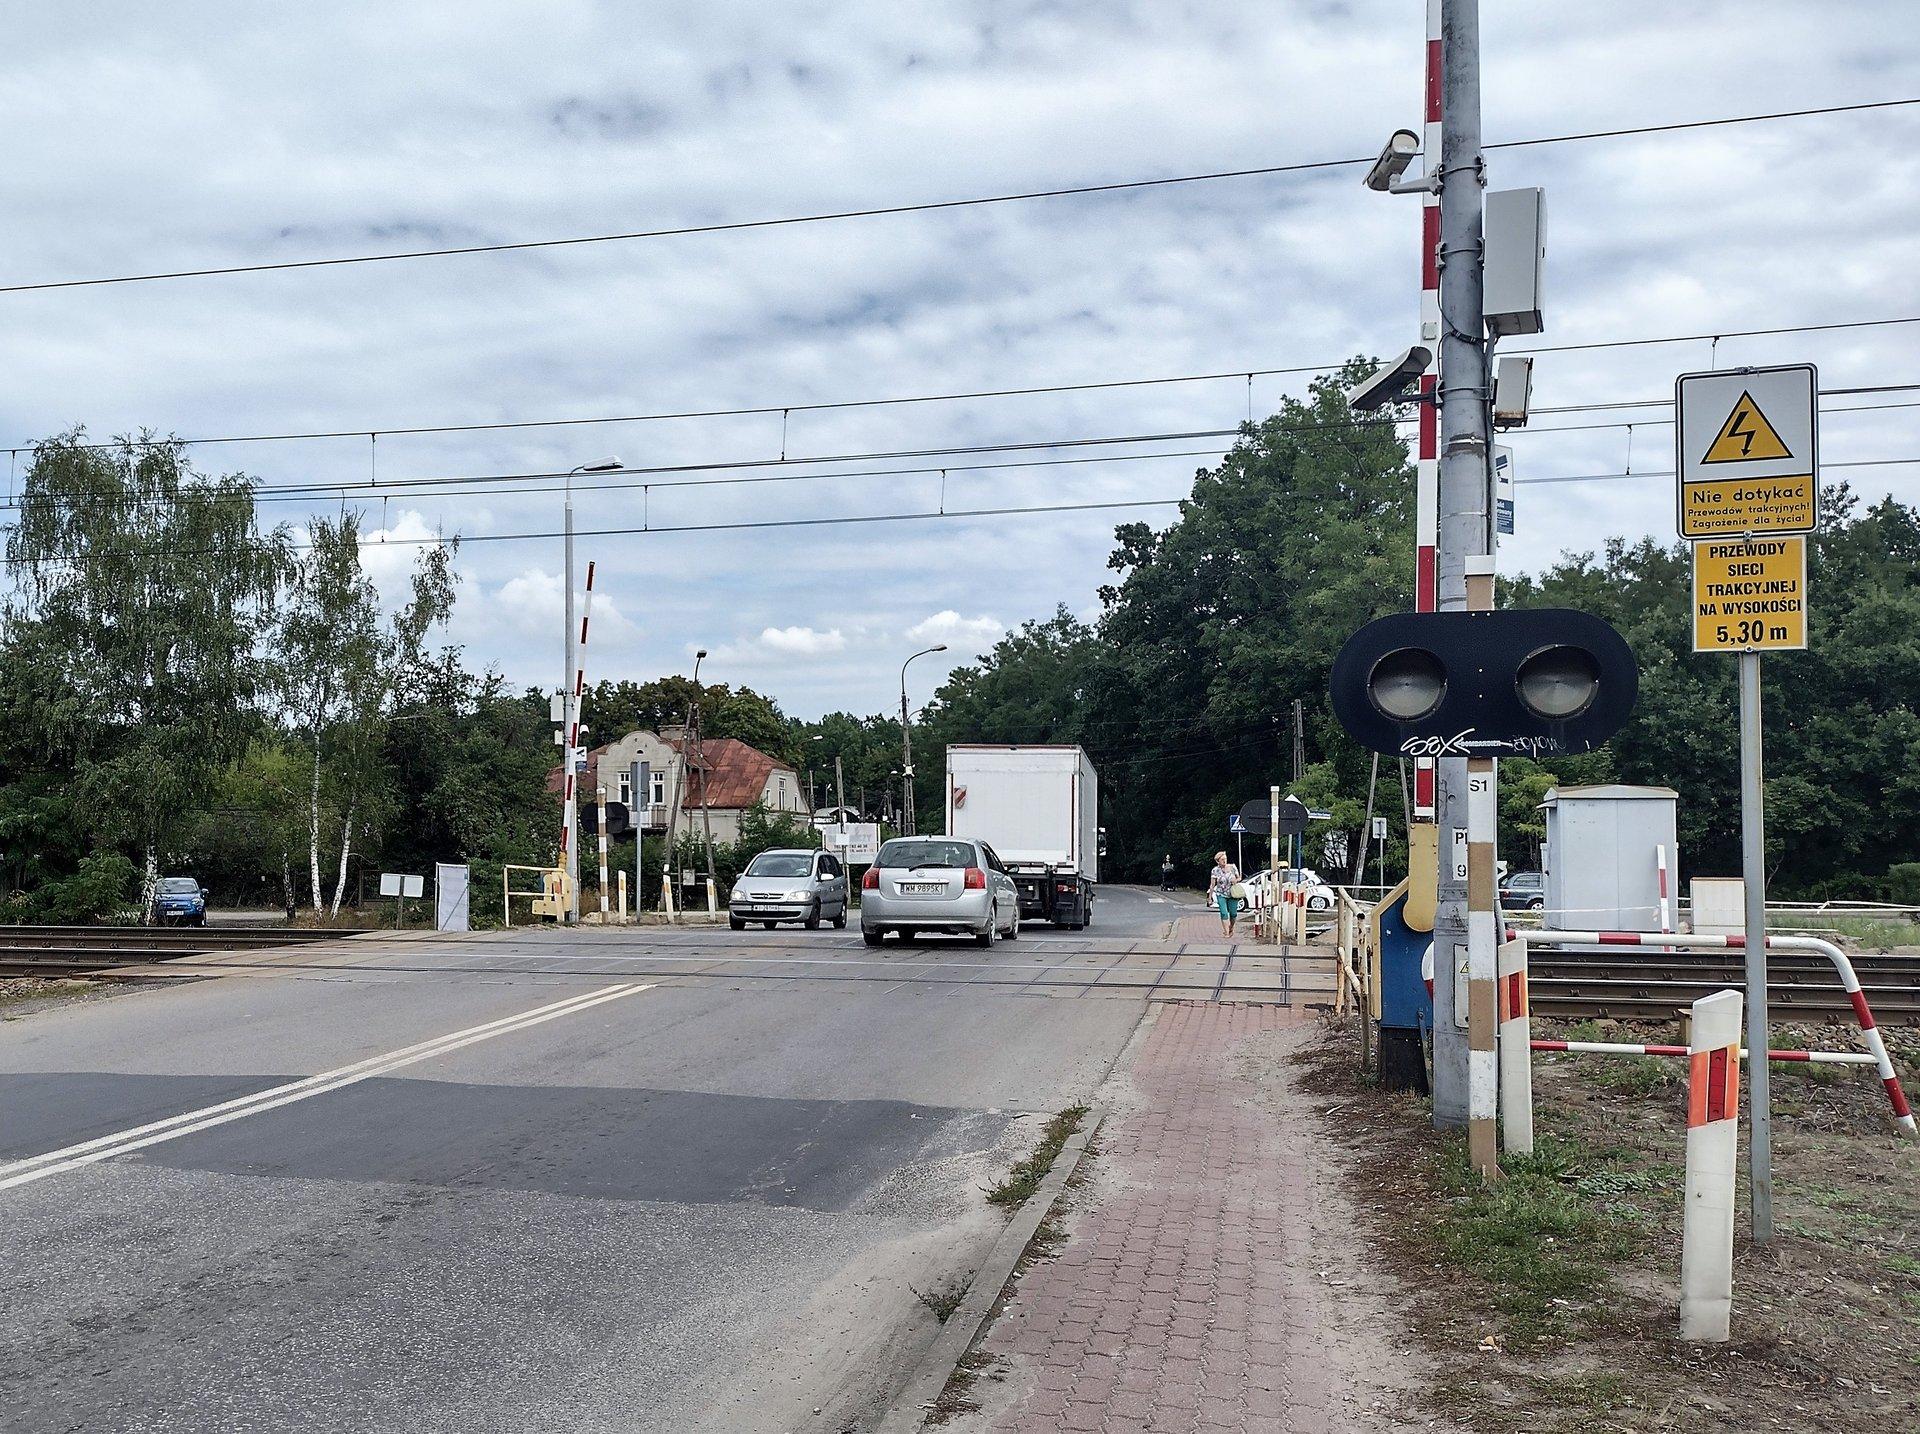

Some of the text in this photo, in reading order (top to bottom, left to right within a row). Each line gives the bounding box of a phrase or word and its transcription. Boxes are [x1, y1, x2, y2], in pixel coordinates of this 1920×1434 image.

[1693, 483, 1804, 504] Nie dotykać
[1688, 503, 1810, 517] Przewodów trakcyjnych!
[1692, 514, 1805, 529] Zagrożenie dla życia!
[1710, 542, 1786, 559] PRZEWODY
[1728, 563, 1764, 577] SIECI
[1707, 580, 1796, 597] TRAKCYJNEJ
[1700, 597, 1801, 616] NA WYSOKOŚCI
[1717, 620, 1788, 644] 5,30 m
[1470, 780, 1488, 792] S1
[1457, 865, 1467, 877] 9
